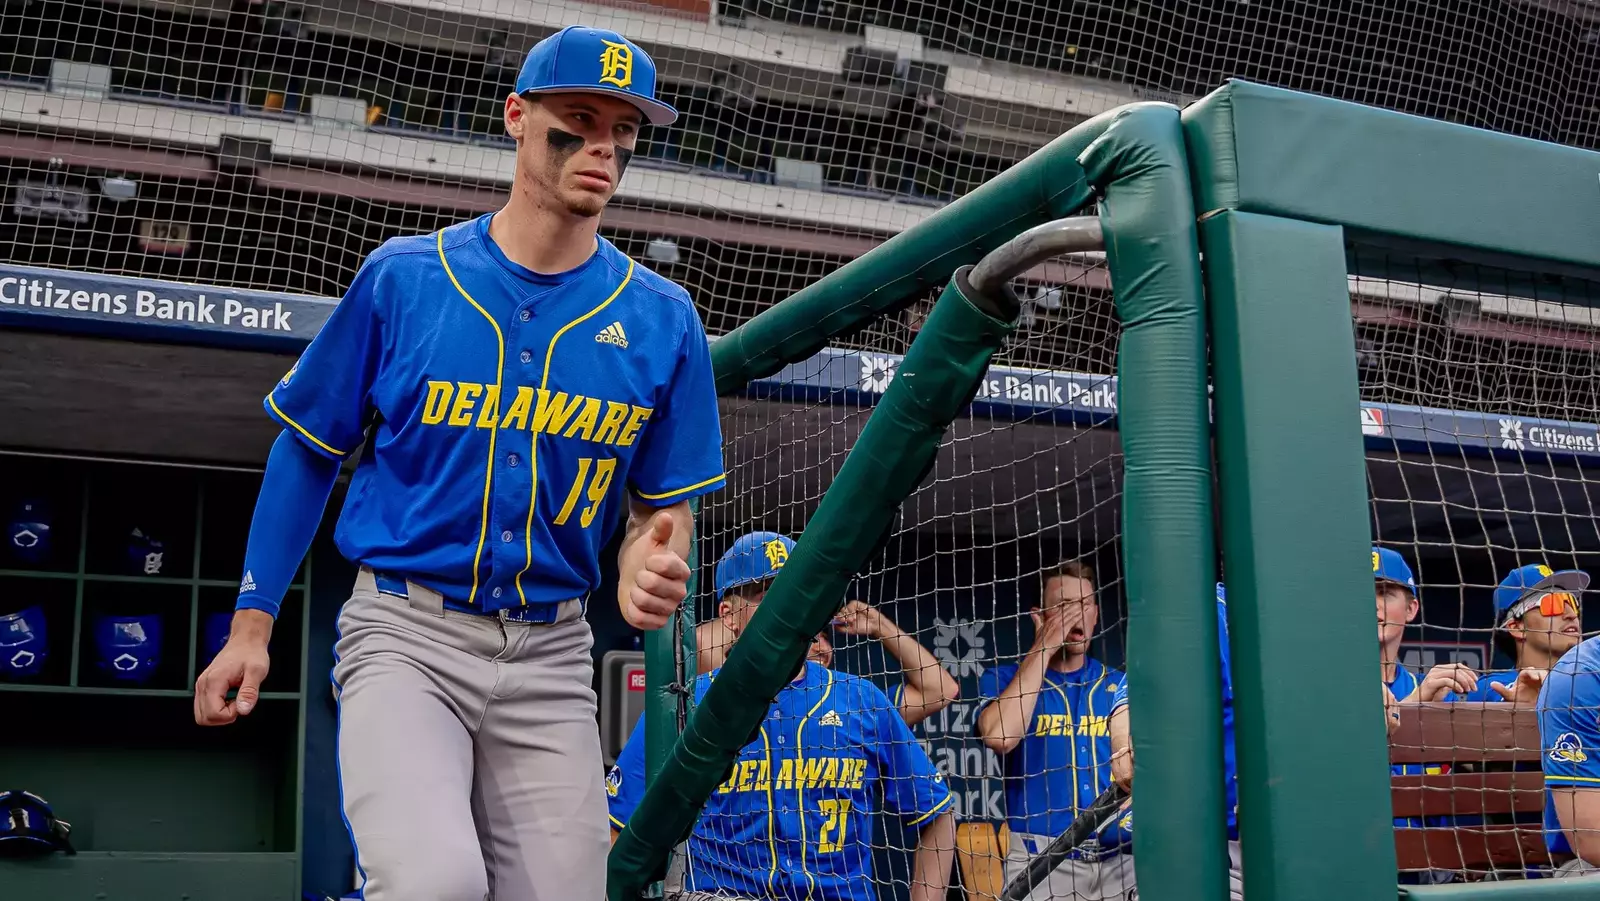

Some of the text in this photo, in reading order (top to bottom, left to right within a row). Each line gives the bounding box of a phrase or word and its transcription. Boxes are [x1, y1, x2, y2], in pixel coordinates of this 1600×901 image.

[0, 277, 292, 331] Citizens Bank Park
[595, 334, 629, 348] adidas
[1005, 376, 1063, 403] Bank
[1068, 382, 1117, 409] Park
[421, 380, 654, 446] DELAWARE
[1529, 426, 1593, 451] Citizens
[553, 457, 617, 528] 19
[631, 674, 645, 687] RE
[1035, 714, 1111, 737] DELAW
[817, 799, 852, 853] 21
